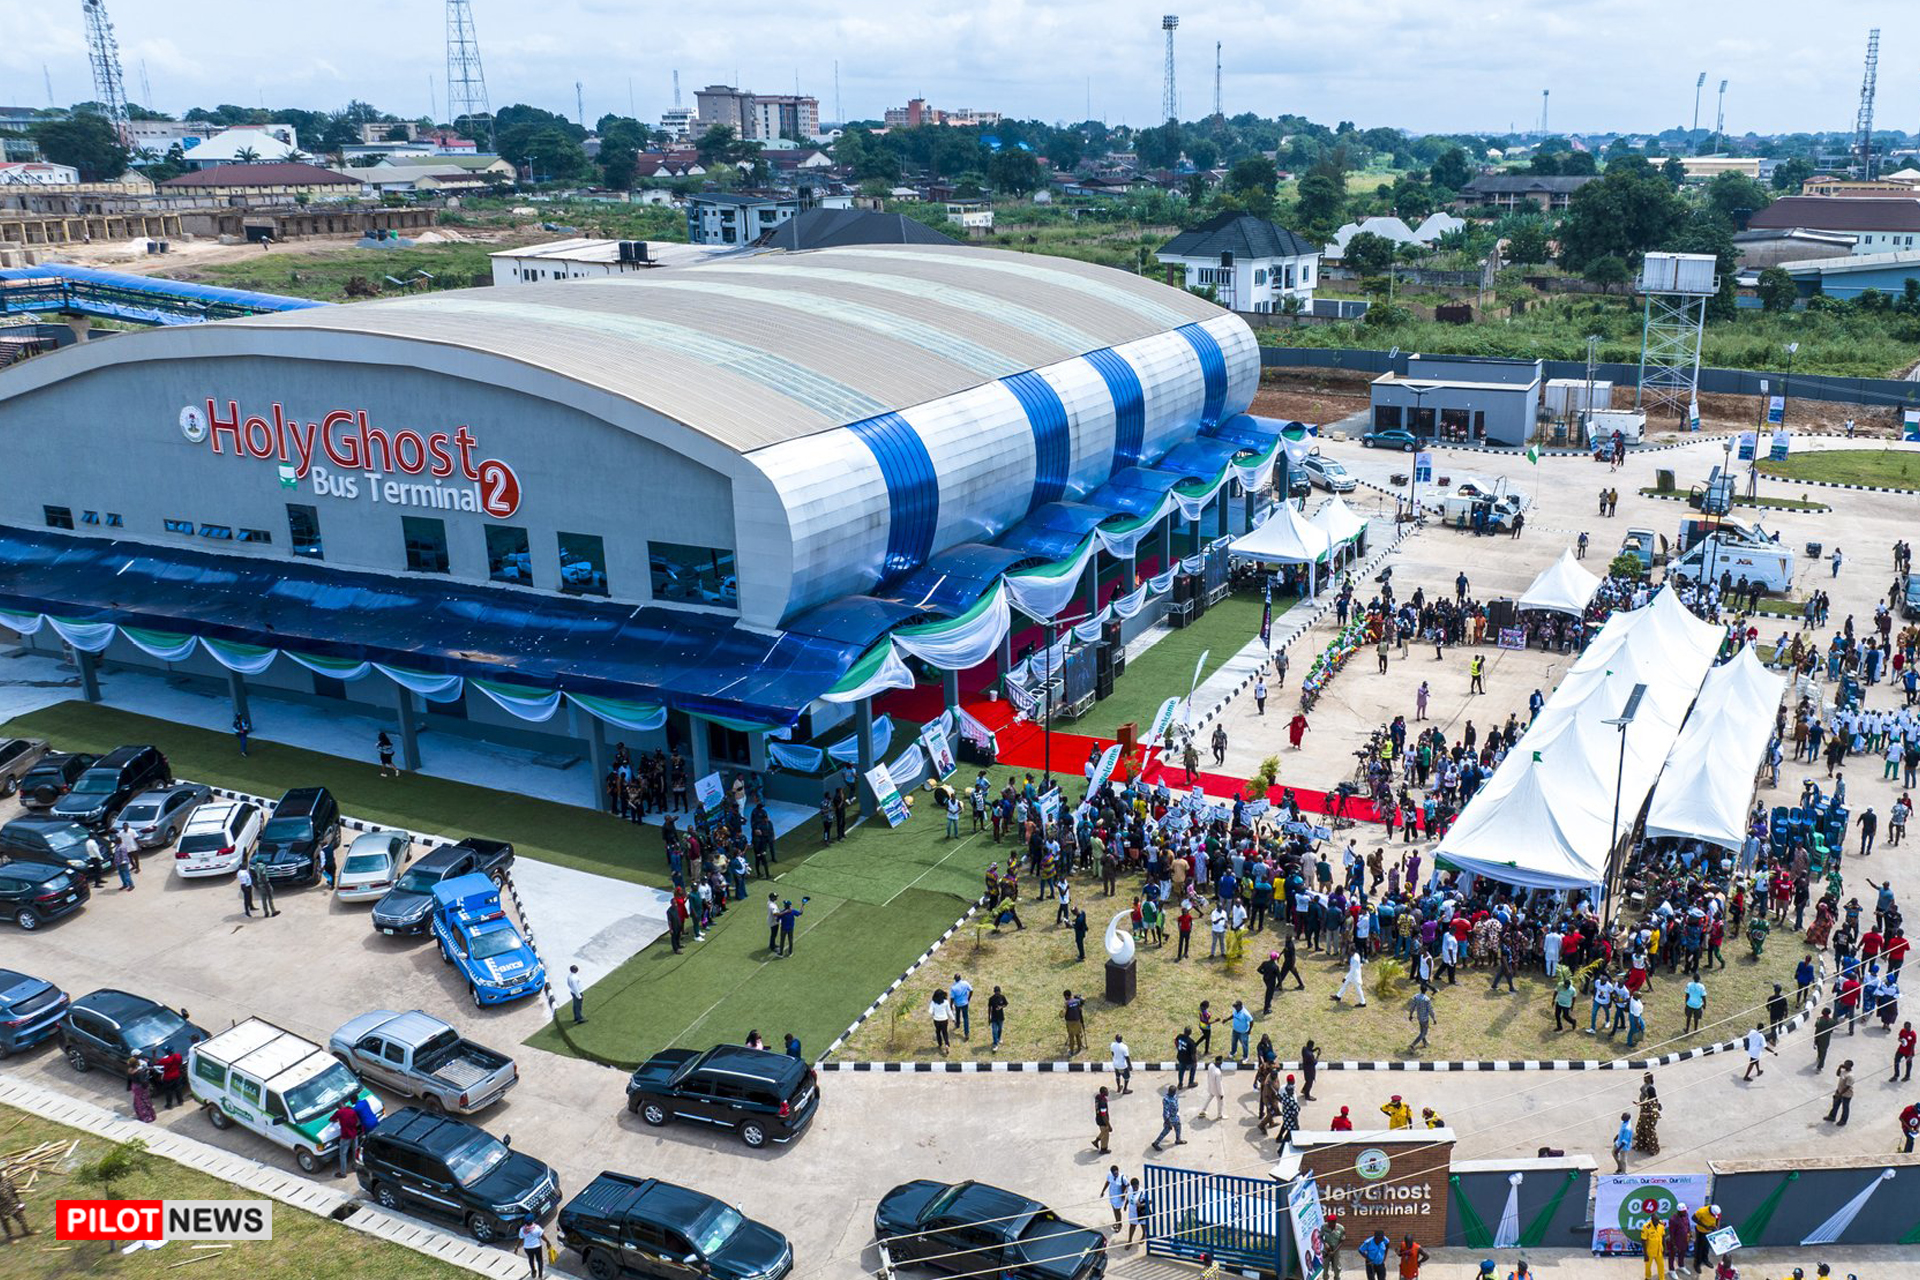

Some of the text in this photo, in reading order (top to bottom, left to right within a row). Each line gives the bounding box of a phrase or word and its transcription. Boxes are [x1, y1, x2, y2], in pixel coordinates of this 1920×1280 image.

[311, 466, 511, 513] Bus Terminal 2
[1352, 1203, 1418, 1216] Terminal
[1421, 1202, 1431, 1215] 2
